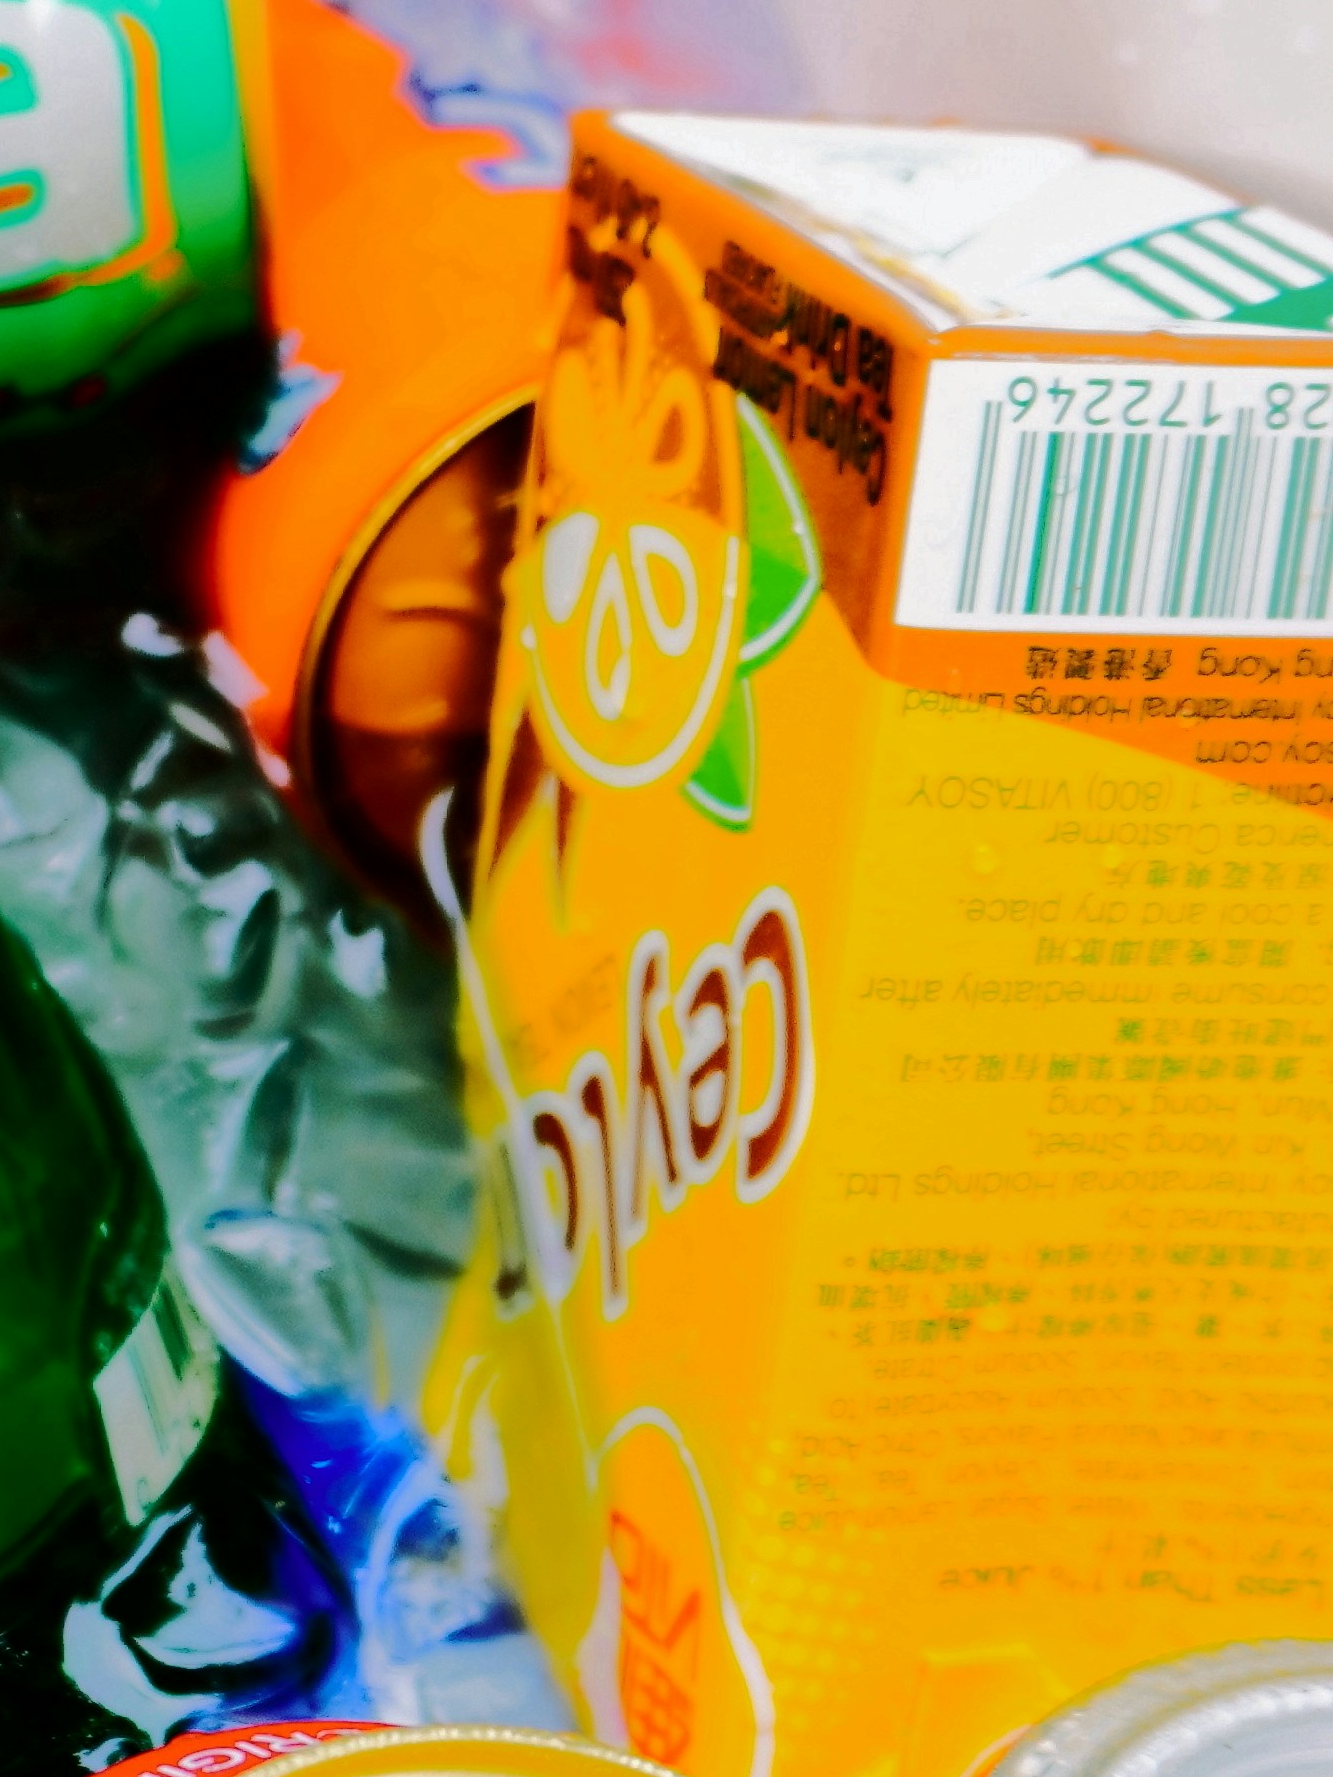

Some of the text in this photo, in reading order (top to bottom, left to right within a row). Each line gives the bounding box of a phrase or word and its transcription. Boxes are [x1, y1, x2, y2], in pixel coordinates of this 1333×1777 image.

[1007, 376, 1222, 427] 172246
[1196, 647, 1283, 685] Kong
[902, 686, 1301, 725] International Holdings Limited
[905, 772, 1172, 811] (800) VITASOY
[1043, 820, 1221, 855] Customer
[957, 893, 1293, 929] cool and dry place.
[860, 977, 943, 1009] after
[951, 971, 1153, 1009] immediately
[1046, 1086, 1238, 1119] Hong Kong
[1027, 1126, 1237, 1162] Wong Street,
[836, 1166, 1269, 1202] International Holdings Ltd.
